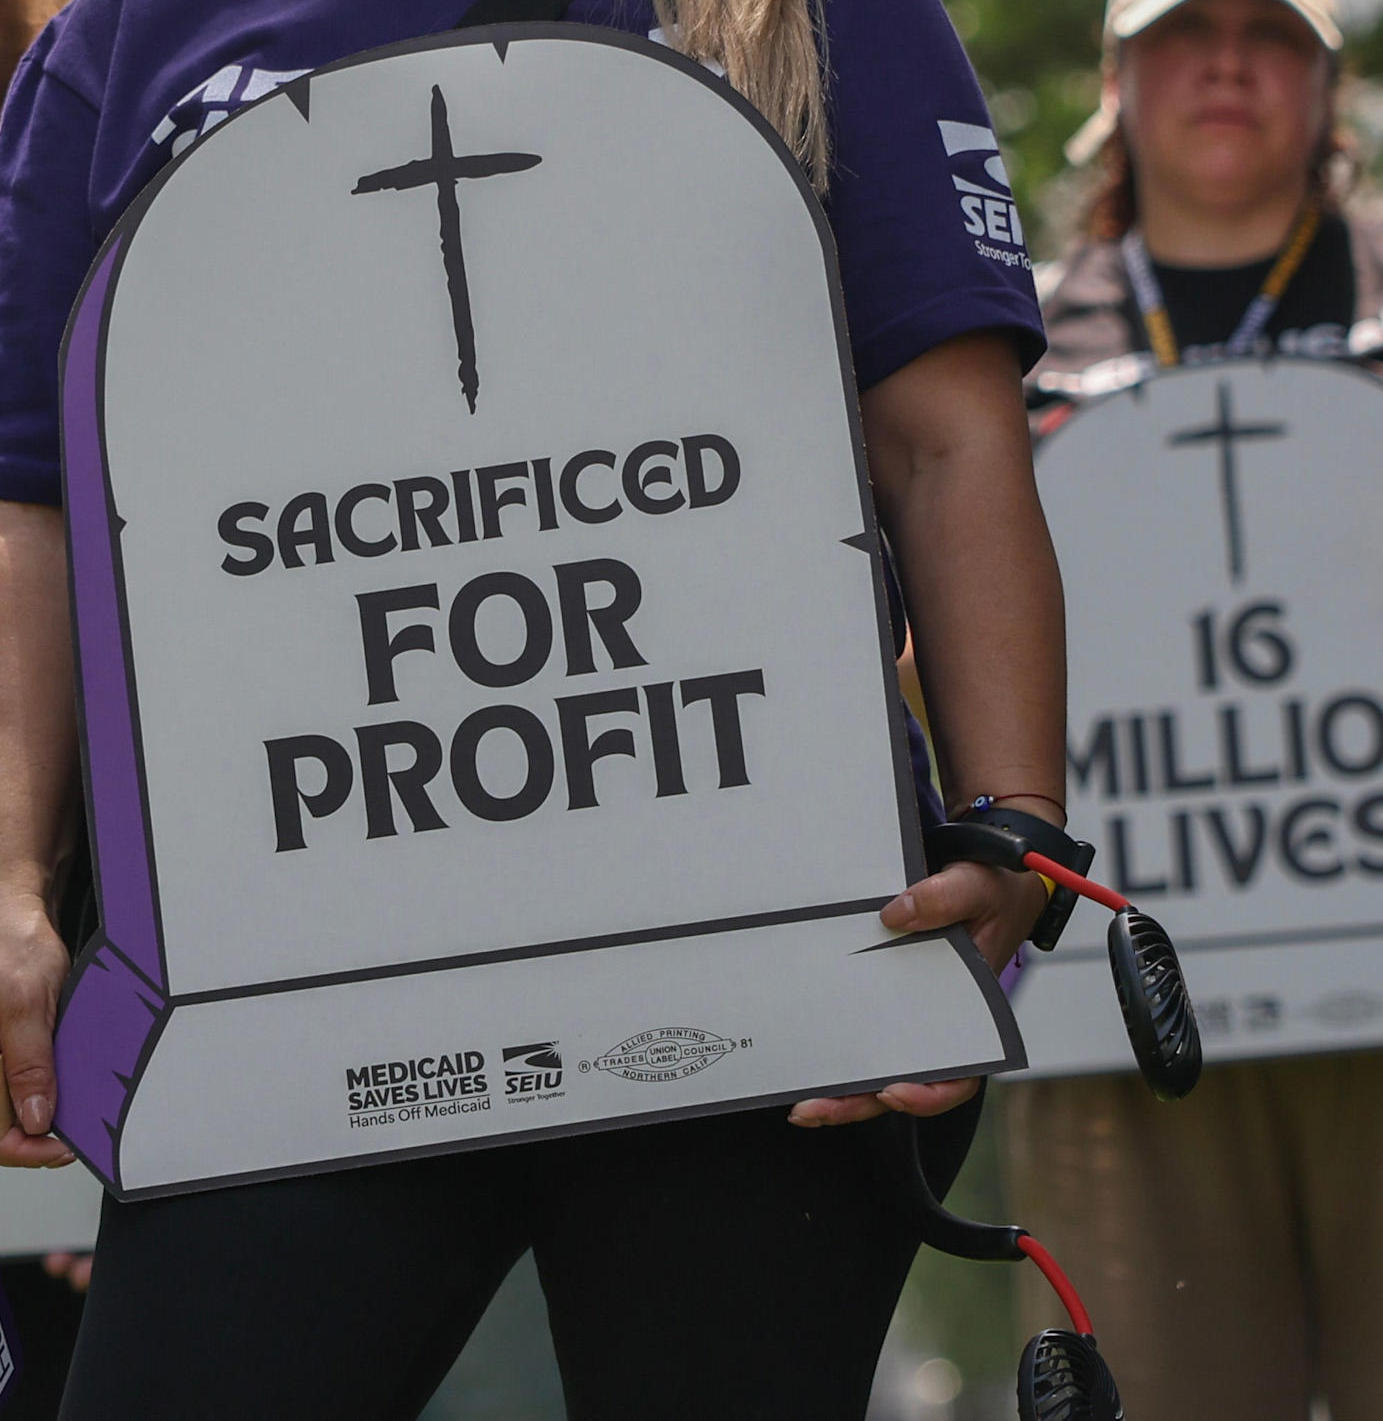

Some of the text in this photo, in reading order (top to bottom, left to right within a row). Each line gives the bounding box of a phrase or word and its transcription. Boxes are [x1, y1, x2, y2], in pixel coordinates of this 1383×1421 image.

[975, 240, 1018, 267] Stronger
[218, 434, 741, 576] SACRIFICED
[355, 558, 650, 705] FOR
[1194, 599, 1294, 692] 16
[263, 669, 766, 852] PROFIT
[620, 1029, 706, 1053] ALLIED PRINTING
[649, 1044, 678, 1056] UNION
[740, 1038, 754, 1049] 81
[602, 1043, 728, 1068] TRADES COUNCIL
[650, 1054, 679, 1065] LABEL
[346, 1050, 485, 1090] MEDICAID
[622, 1057, 710, 1082] NORTHERN CALIF
[348, 1074, 488, 1110] SAVES LIVES
[505, 1071, 563, 1095] SEIU
[507, 1091, 566, 1105] Stronger Together
[349, 1097, 491, 1128] Hands Off Medicaid
